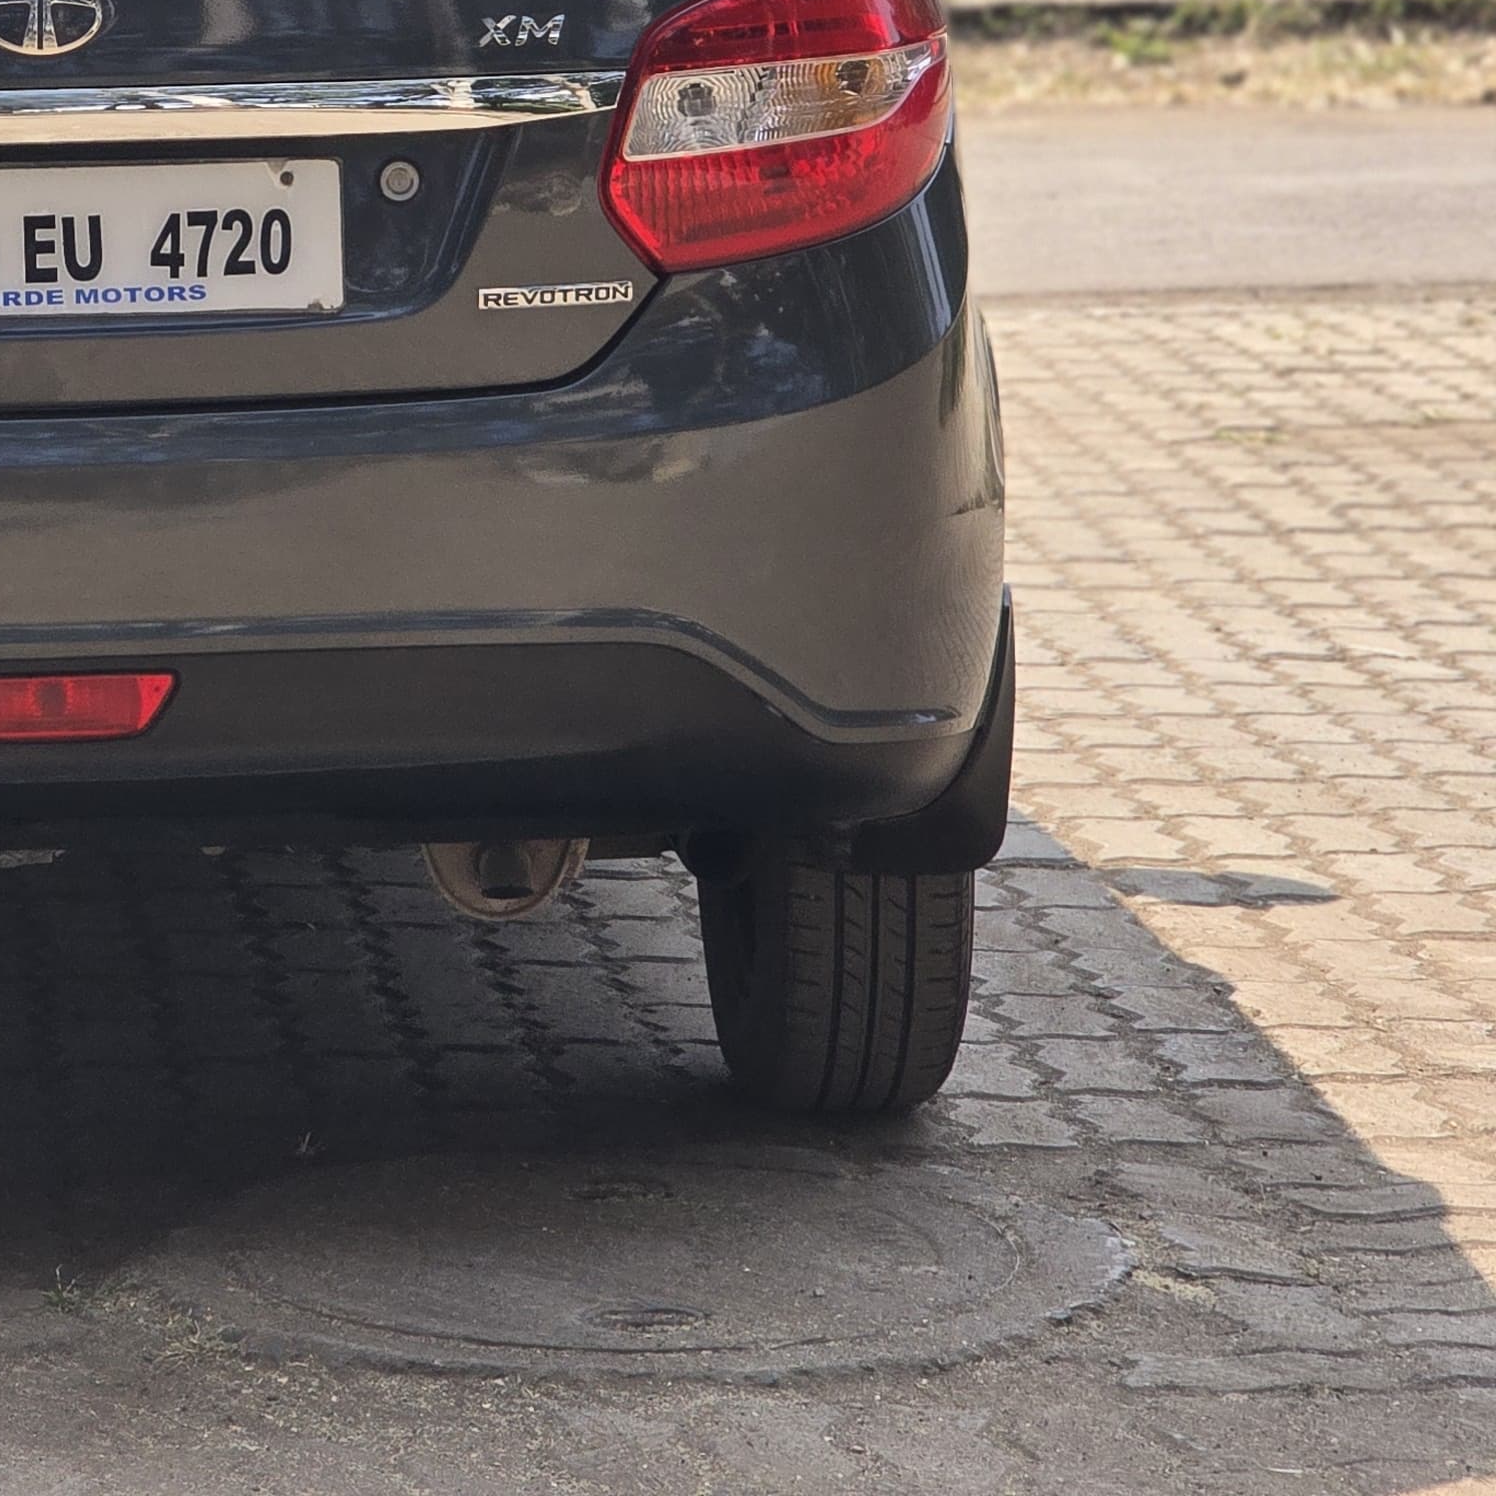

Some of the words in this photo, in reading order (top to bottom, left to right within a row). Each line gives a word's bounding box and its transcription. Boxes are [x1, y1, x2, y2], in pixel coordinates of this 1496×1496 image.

[478, 14, 566, 47] XM
[23, 214, 103, 283] EU
[149, 207, 293, 279] 4720
[74, 284, 207, 305] MOTORS
[482, 284, 631, 308] REVOTRON
